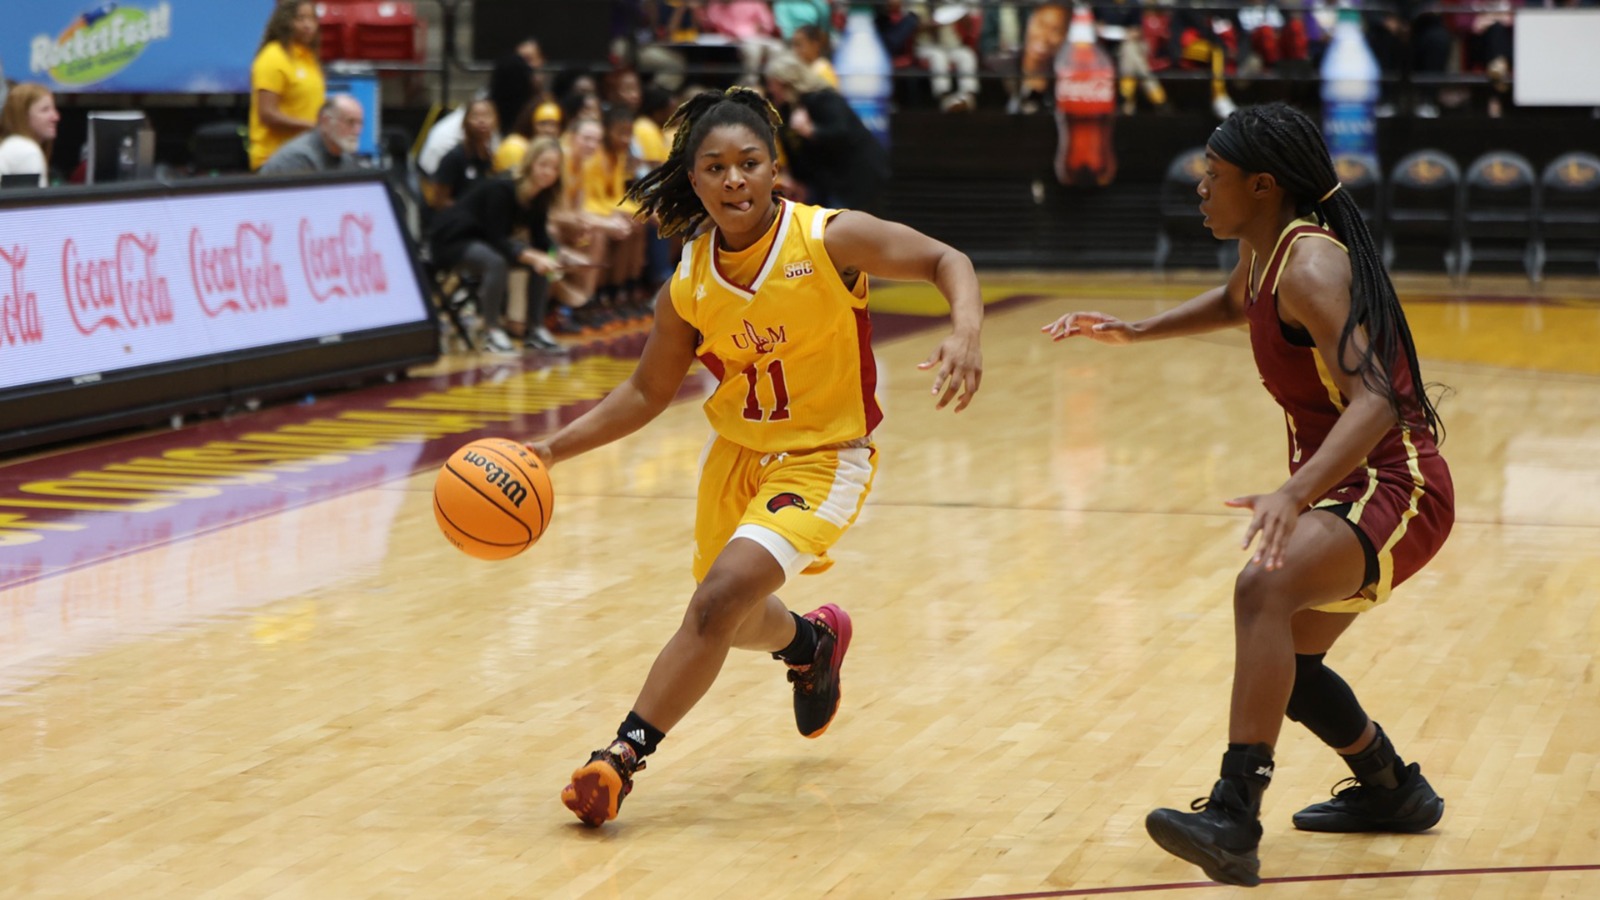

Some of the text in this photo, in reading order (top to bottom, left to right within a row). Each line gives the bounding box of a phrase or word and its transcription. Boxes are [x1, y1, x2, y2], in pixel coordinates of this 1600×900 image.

[783, 260, 814, 279] SBC
[740, 359, 790, 422] 11
[462, 450, 528, 509] Wilson
